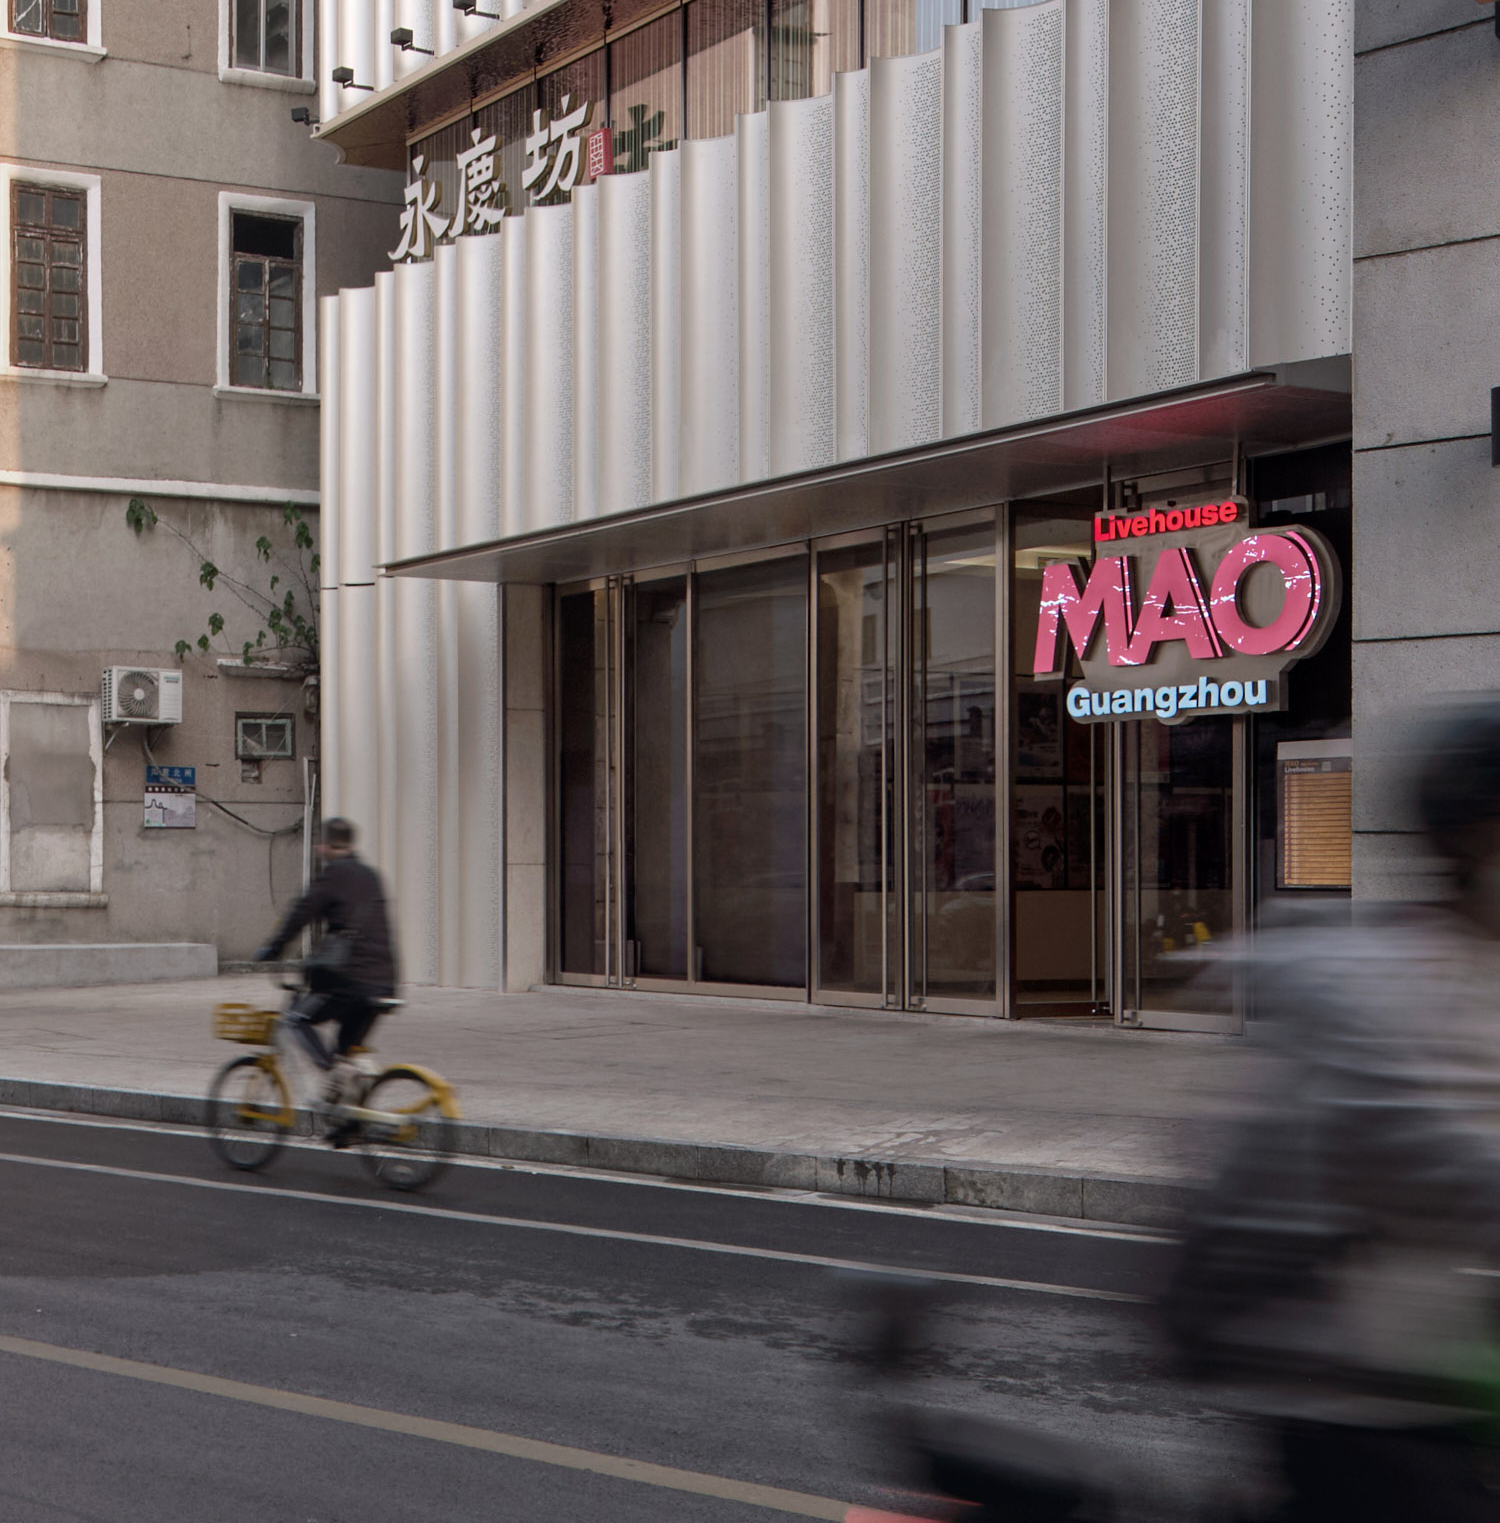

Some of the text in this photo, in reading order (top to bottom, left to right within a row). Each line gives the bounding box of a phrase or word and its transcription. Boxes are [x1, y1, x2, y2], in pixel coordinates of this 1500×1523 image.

[387, 93, 594, 262] 永慶坊
[1094, 501, 1238, 542] Livehouse
[1033, 530, 1321, 674] MAO
[1066, 676, 1268, 718] Guangzhou
